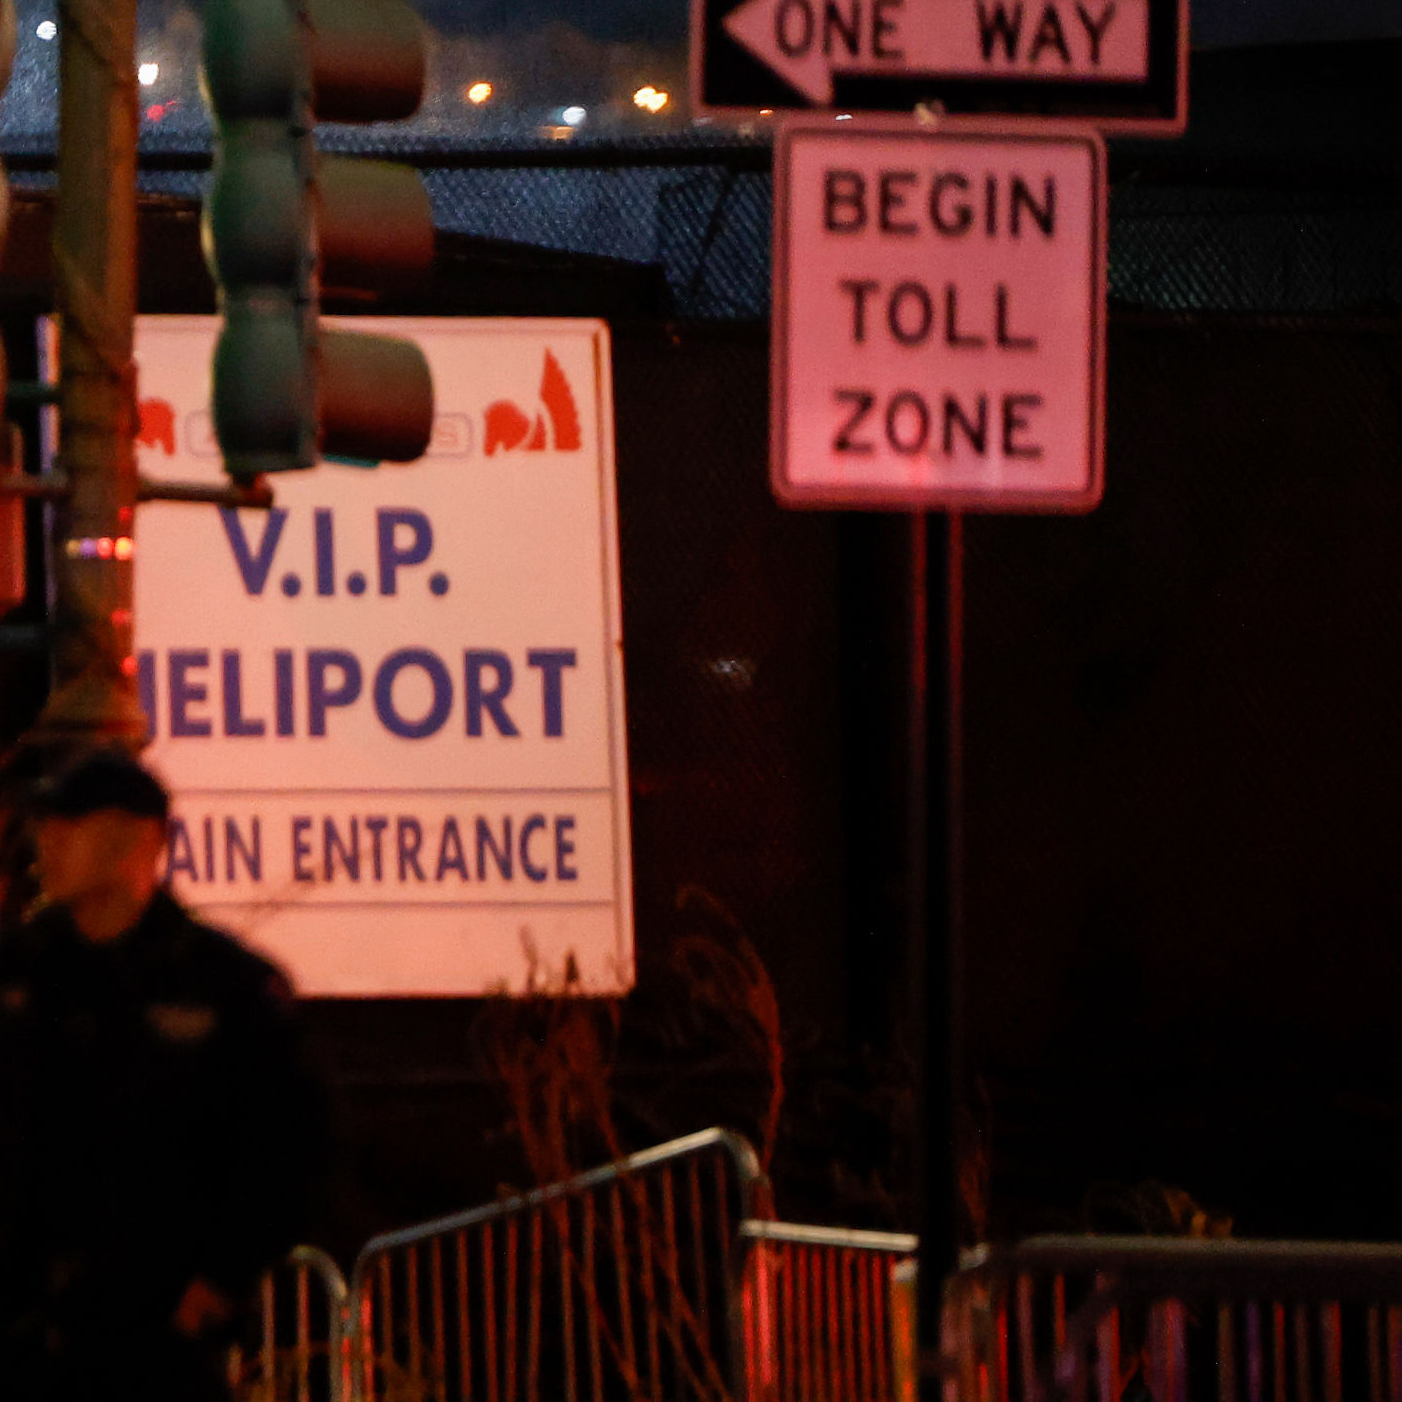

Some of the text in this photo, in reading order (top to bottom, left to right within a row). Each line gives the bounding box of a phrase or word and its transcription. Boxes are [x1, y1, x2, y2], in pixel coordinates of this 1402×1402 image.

[975, 0, 1115, 64] WAY
[823, 171, 1057, 239] BEGIN
[838, 280, 1037, 348] TOLL
[833, 390, 1043, 457] ZONE
[214, 507, 450, 597] V.I.P.
[164, 815, 578, 882] AIN ENTRANCE
